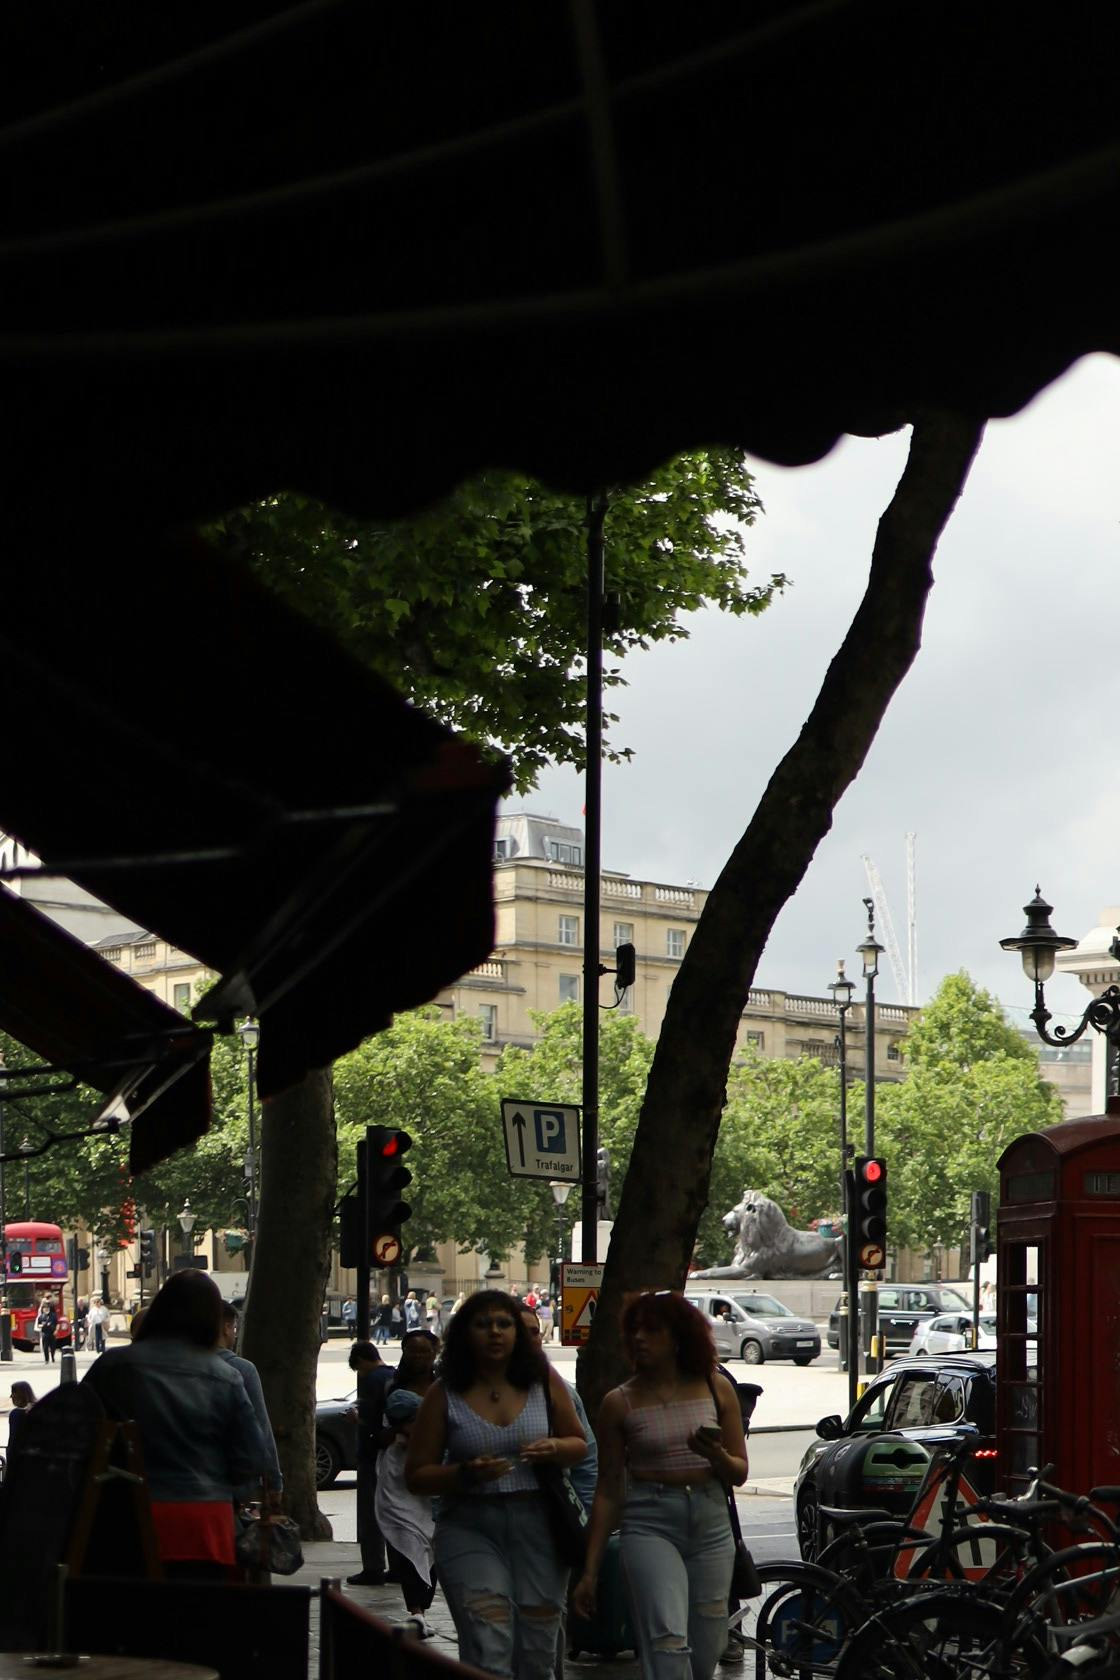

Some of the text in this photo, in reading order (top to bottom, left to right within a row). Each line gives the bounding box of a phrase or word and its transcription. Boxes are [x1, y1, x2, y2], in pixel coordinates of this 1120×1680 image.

[540, 1114, 560, 1149] P
[535, 1159, 574, 1173] Trafalgar
[566, 1268, 593, 1276] Warning
